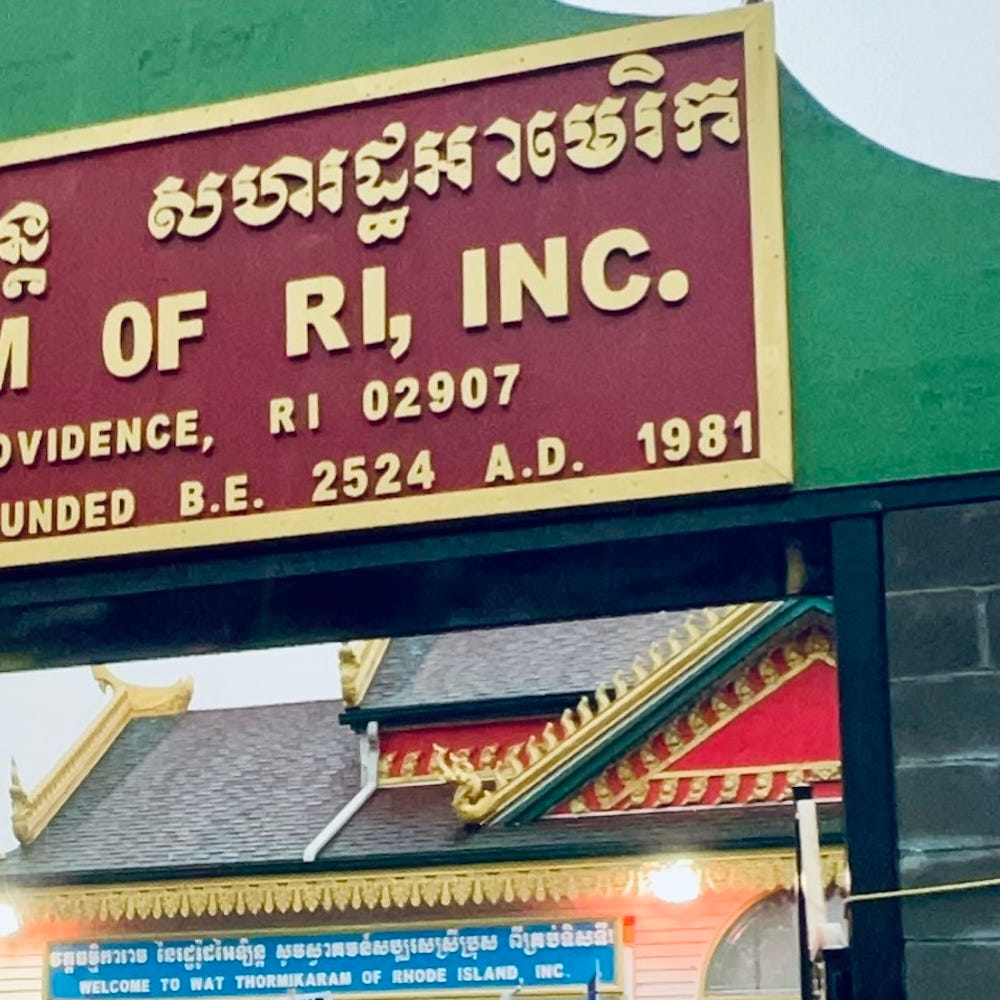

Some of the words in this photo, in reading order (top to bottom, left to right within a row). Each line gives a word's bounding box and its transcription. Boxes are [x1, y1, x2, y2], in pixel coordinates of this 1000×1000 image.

[102, 290, 207, 378] OF
[285, 265, 412, 359] RI,
[462, 227, 689, 328] INC.
[269, 393, 319, 434] RI
[362, 363, 520, 421] 02907
[180, 474, 264, 517] B.E.
[311, 449, 435, 502] 2524
[484, 436, 584, 483] A.D.
[637, 410, 753, 464] 1981
[79, 978, 150, 995] WELCOME
[161, 977, 180, 992] TO
[190, 975, 224, 992] WAT
[235, 970, 352, 990] THORMIKARAM
[362, 969, 382, 985] OF
[392, 967, 447, 984] RHODE
